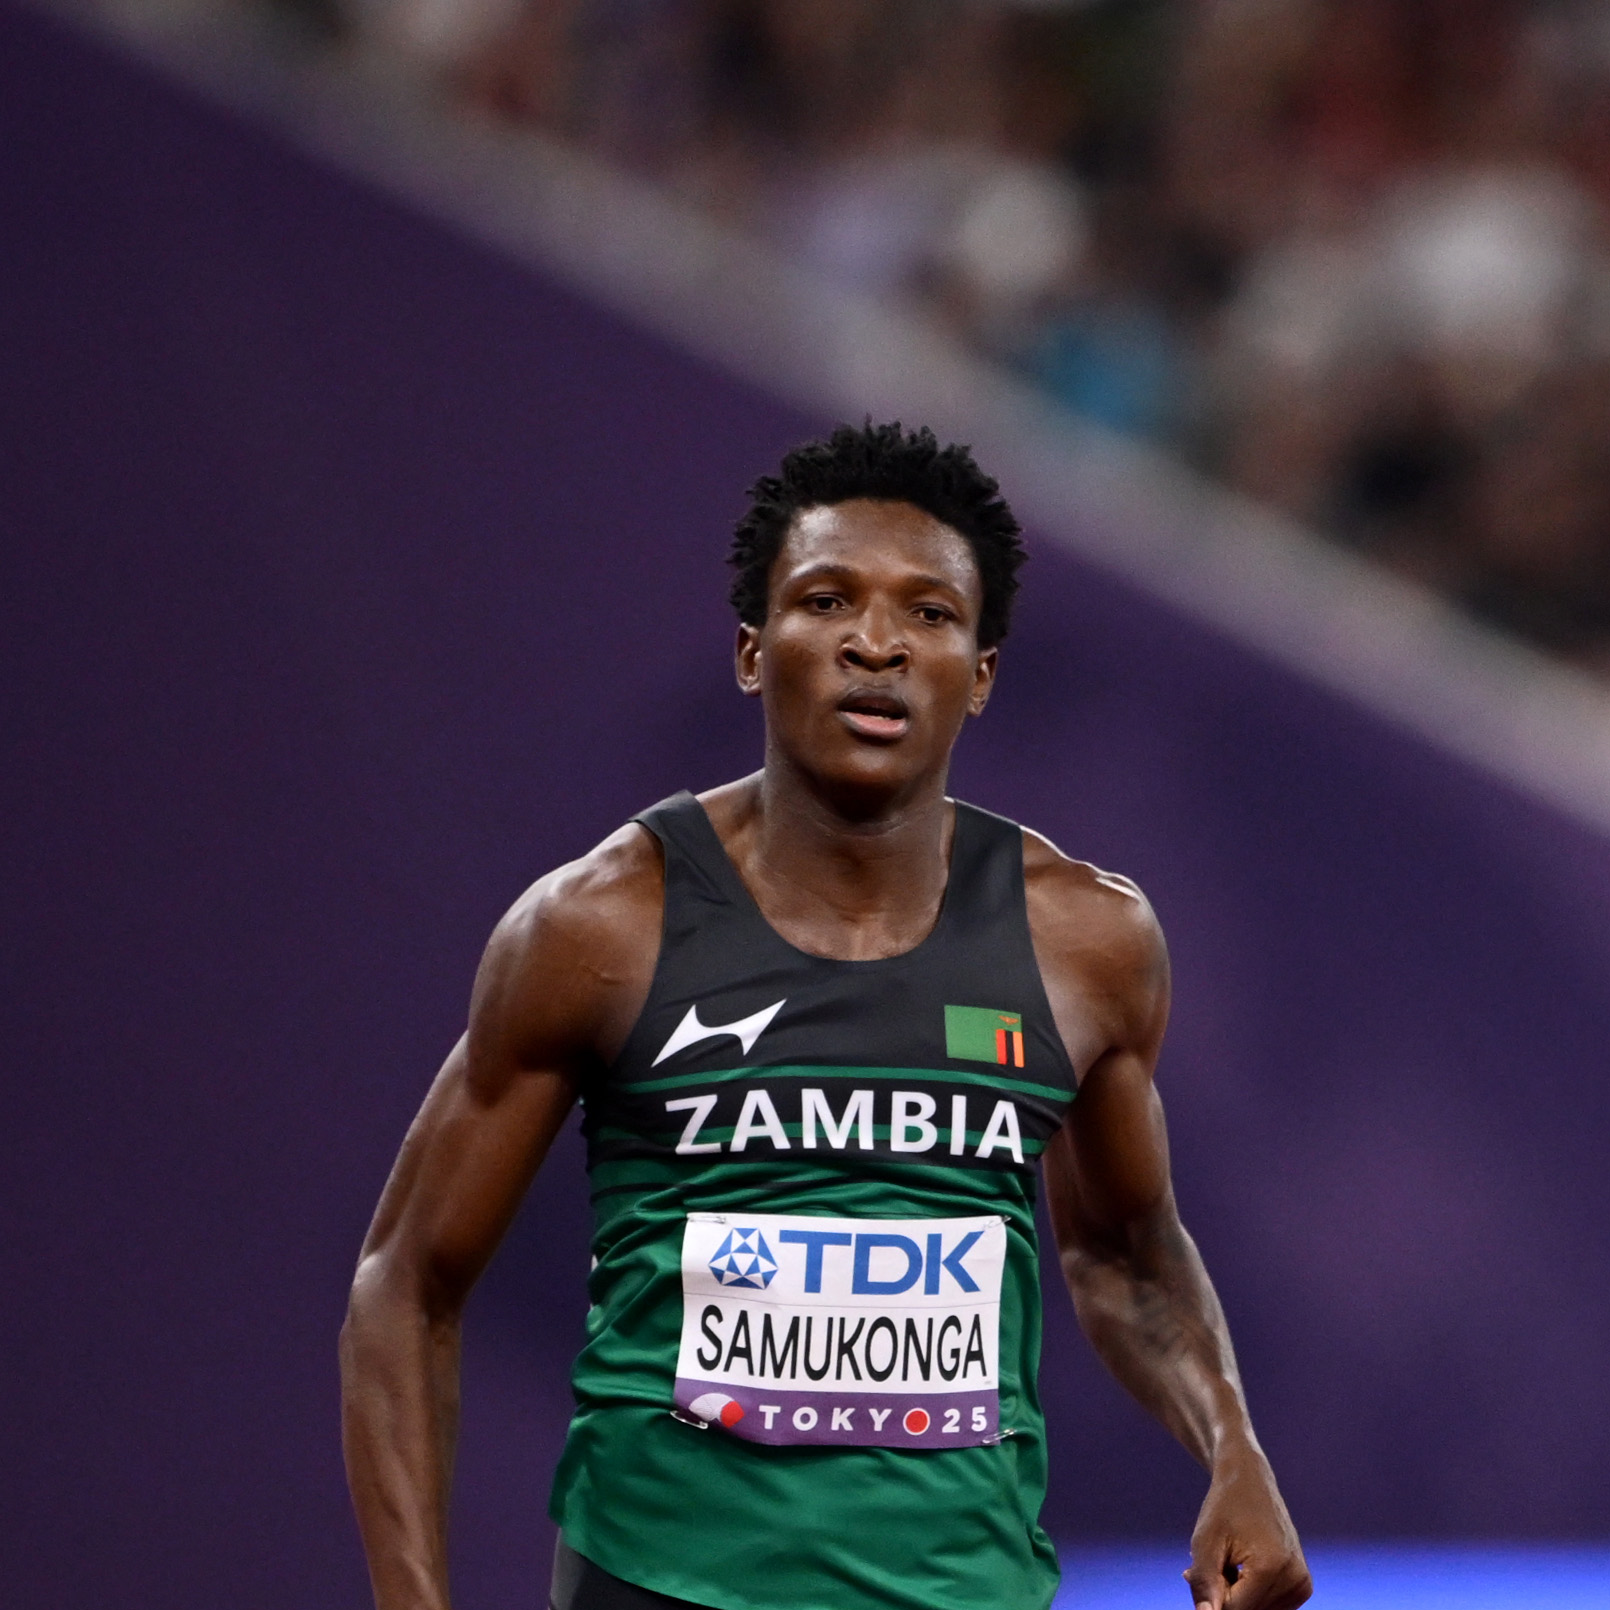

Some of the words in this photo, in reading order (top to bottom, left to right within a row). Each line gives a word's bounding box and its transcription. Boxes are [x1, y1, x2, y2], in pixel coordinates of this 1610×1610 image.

[665, 1088, 1025, 1164] ZAMBIA
[779, 1230, 985, 1296] TDK
[697, 1304, 988, 1382] SAMUKONGA
